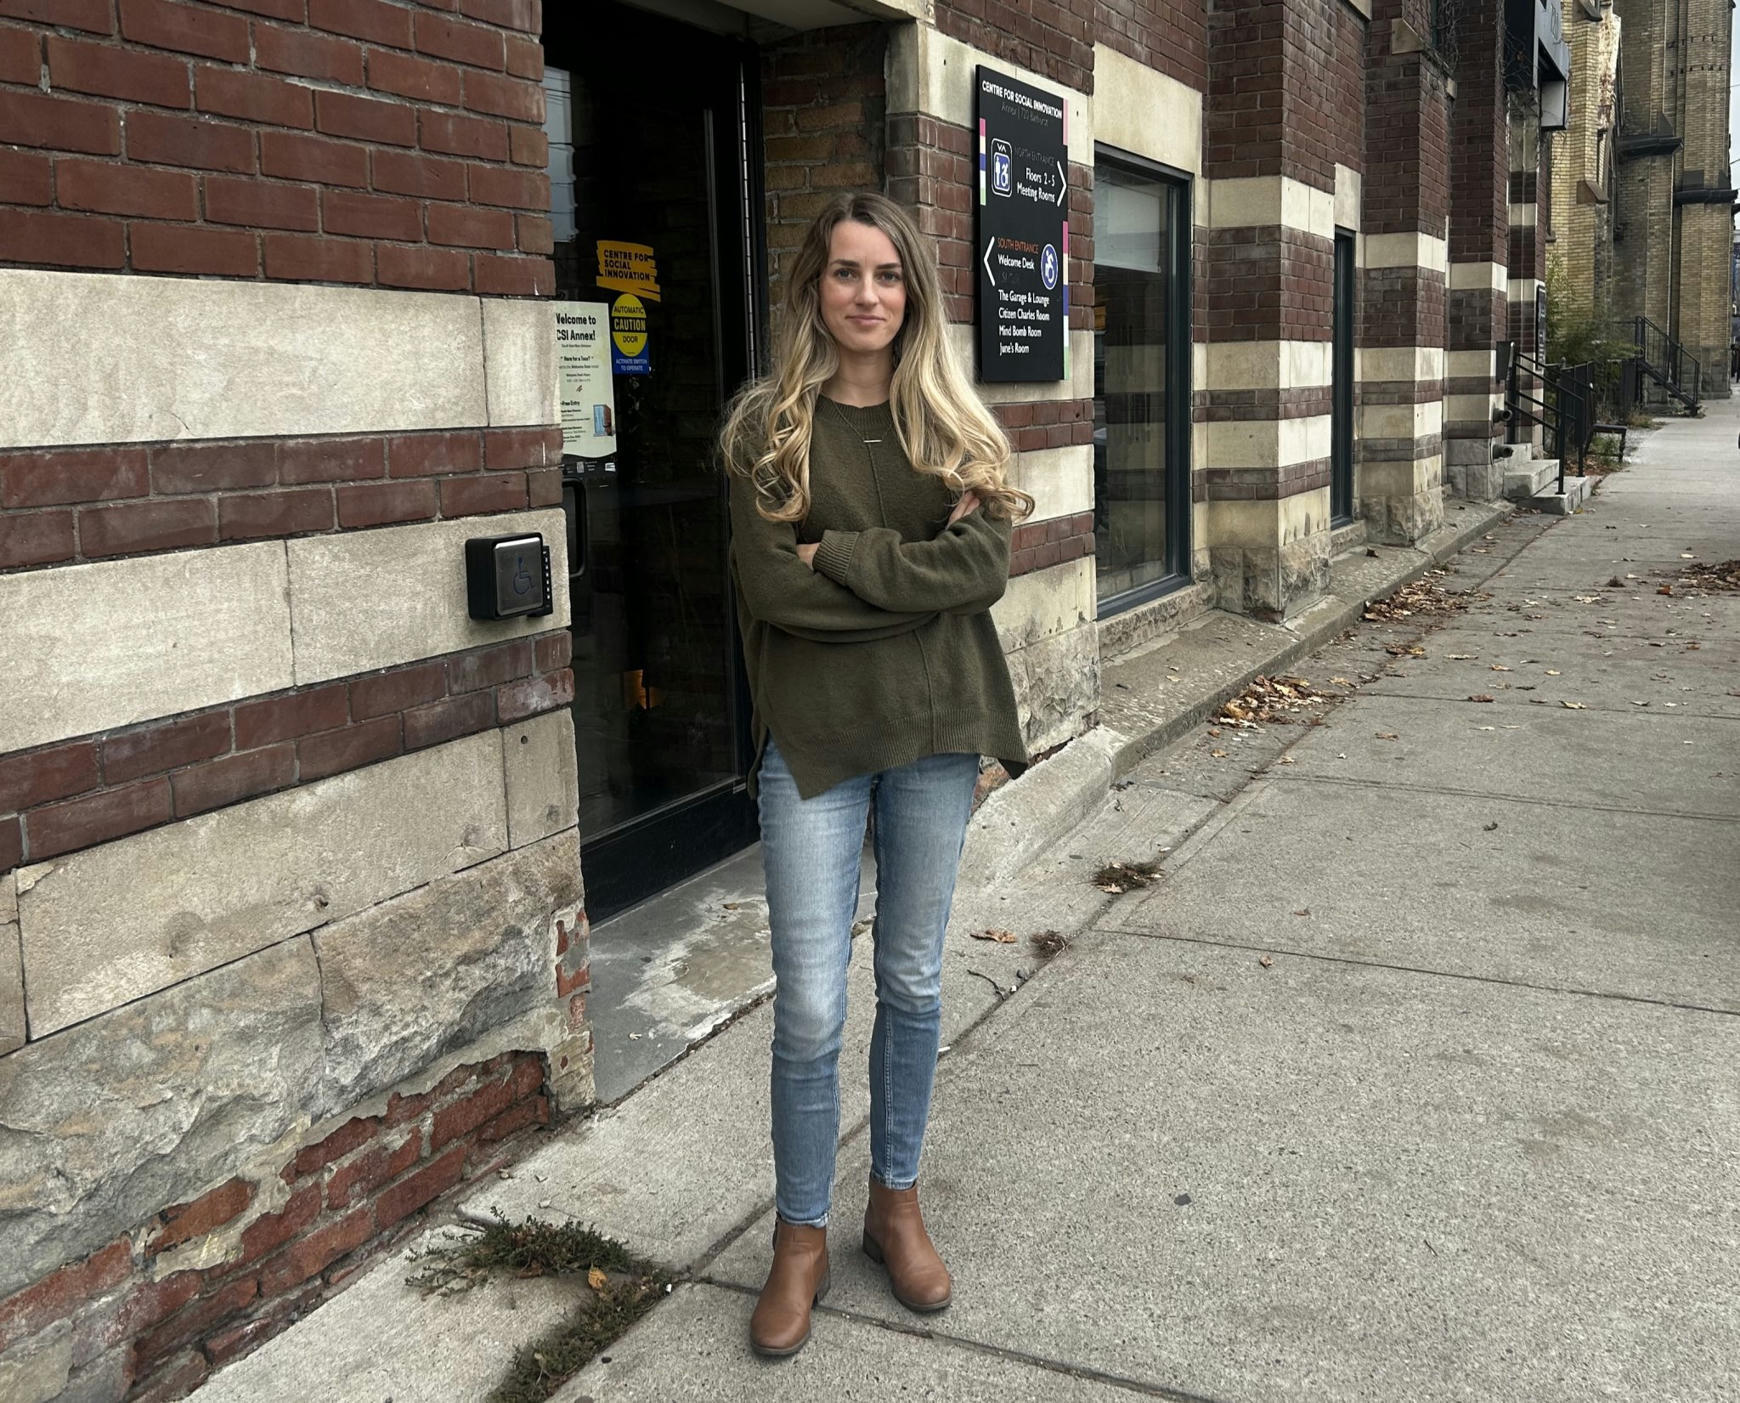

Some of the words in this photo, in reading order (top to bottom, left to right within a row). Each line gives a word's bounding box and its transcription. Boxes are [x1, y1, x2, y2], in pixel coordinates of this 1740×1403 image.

[982, 80, 1003, 98] CENTRE
[1004, 88, 1014, 102] FOR
[1014, 92, 1033, 109] SOCIAL
[1033, 100, 1062, 119] INNOVATION
[1026, 168, 1042, 184] Floors
[1044, 172, 1048, 184] 2
[1052, 174, 1055, 186] 5
[1016, 182, 1038, 202] Meeting
[1038, 187, 1055, 202] Rooms
[997, 237, 1014, 250] SOUTH
[1015, 240, 1039, 254] ENTRANCE
[604, 250, 632, 260] CENTRE
[635, 253, 648, 262] FOR
[998, 252, 1022, 268] Welcome
[1022, 257, 1035, 270] Desk
[604, 260, 631, 270] SOCIAL
[604, 269, 650, 281] INNOVATION
[998, 289, 1008, 301] The
[1010, 290, 1027, 306] Garage
[1028, 292, 1032, 303] &
[1032, 293, 1050, 308] Lounge
[588, 315, 596, 324] to
[998, 307, 1016, 318] Citizen
[1017, 308, 1035, 320] Charles
[1036, 310, 1050, 320] Room
[614, 318, 646, 331] CAUTION
[999, 325, 1011, 336] Mind
[1012, 326, 1026, 336] Bomb
[1028, 326, 1042, 337] Room
[556, 330, 568, 340] CSI
[570, 330, 596, 340] Annex!
[622, 335, 638, 343] DOOR
[1000, 342, 1014, 356] June's
[1015, 342, 1030, 354] Room
